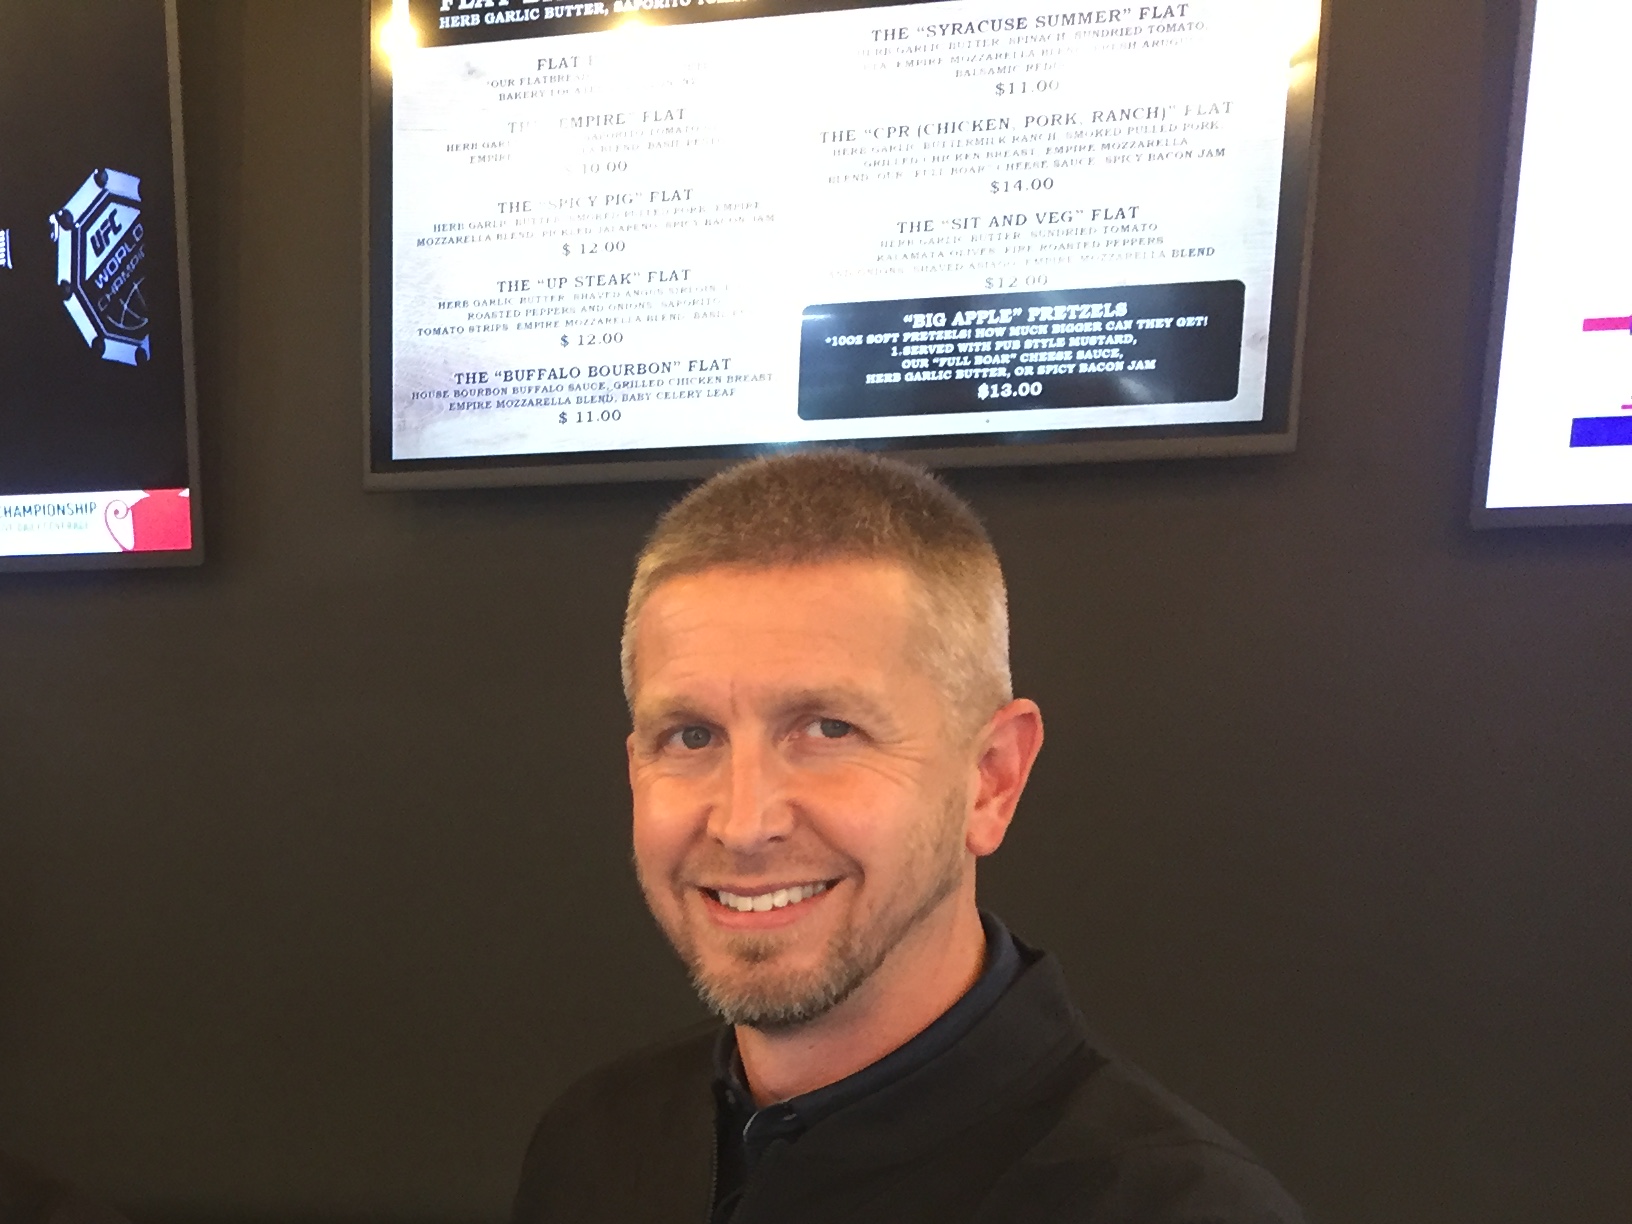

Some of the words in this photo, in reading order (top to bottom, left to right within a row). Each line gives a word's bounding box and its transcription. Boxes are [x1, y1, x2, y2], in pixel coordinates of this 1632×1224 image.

[439, 14, 481, 29] HERB
[485, 8, 540, 24] GARLIC
[544, 2, 610, 19] BUTTER,
[872, 27, 909, 41] THE
[1139, 3, 1188, 20] FLAT
[537, 56, 579, 71] FLAT
[642, 108, 686, 123] FLAT
[820, 129, 856, 143] THE
[1184, 101, 1233, 116] FLAT
[1148, 150, 1193, 161] BACON
[1198, 148, 1226, 158] JAM
[990, 178, 1054, 194] $14.00
[498, 200, 532, 213] THE
[650, 188, 694, 202] FLAT
[897, 220, 934, 234] THE
[989, 213, 1027, 228] AND
[1092, 206, 1139, 221] FLAT
[90, 208, 123, 258] UFC
[417, 233, 492, 247] MOZZARELLA
[95, 223, 144, 289] WORLD
[1172, 247, 1215, 258] BLEND
[497, 279, 531, 293] THE
[647, 268, 692, 283] FLAT
[468, 309, 521, 321] ROASTED
[1027, 302, 1127, 322] PRETZELS
[417, 325, 465, 337] TOMATO
[560, 333, 569, 348] $
[578, 331, 624, 346] 12.00
[866, 333, 900, 344] SOFT
[975, 327, 1007, 337] HOW
[1009, 325, 1048, 336] MUCH
[1052, 322, 1102, 334] BIGGER
[1106, 319, 1133, 331] CAN
[1136, 317, 1174, 329] THEY
[1176, 316, 1208, 327] GET!
[957, 341, 991, 353] WITH
[995, 340, 1021, 351] PUB
[1024, 337, 1065, 349] STYLE
[1069, 334, 1137, 347] MUSTARD,
[902, 359, 929, 369] OUR
[1020, 350, 1072, 363] CHEESE
[1076, 348, 1124, 360] SAUCE,
[454, 371, 489, 385] THE
[688, 358, 732, 372] FLAT
[866, 372, 902, 384] HERB
[904, 370, 952, 382] GARLIC
[955, 367, 1011, 379] BUTTER,
[1014, 366, 1034, 376] OR
[1037, 364, 1076, 375] SPICY
[1079, 361, 1124, 373] BACON
[1127, 359, 1156, 370] JAM
[411, 390, 450, 400] HOUSE
[453, 387, 508, 398] BOURBON
[512, 383, 564, 394] BUFFALO
[613, 379, 665, 390] GRILLED
[668, 375, 722, 386] CHICKEN
[977, 381, 1042, 400] $13.00
[449, 401, 493, 411] EMPIRE
[496, 397, 571, 409] MOZZARELLA
[621, 392, 652, 402] BABY
[656, 389, 703, 400] CELERY
[707, 387, 736, 398] LEAF
[558, 411, 568, 425] $
[576, 409, 622, 423] 11.00
